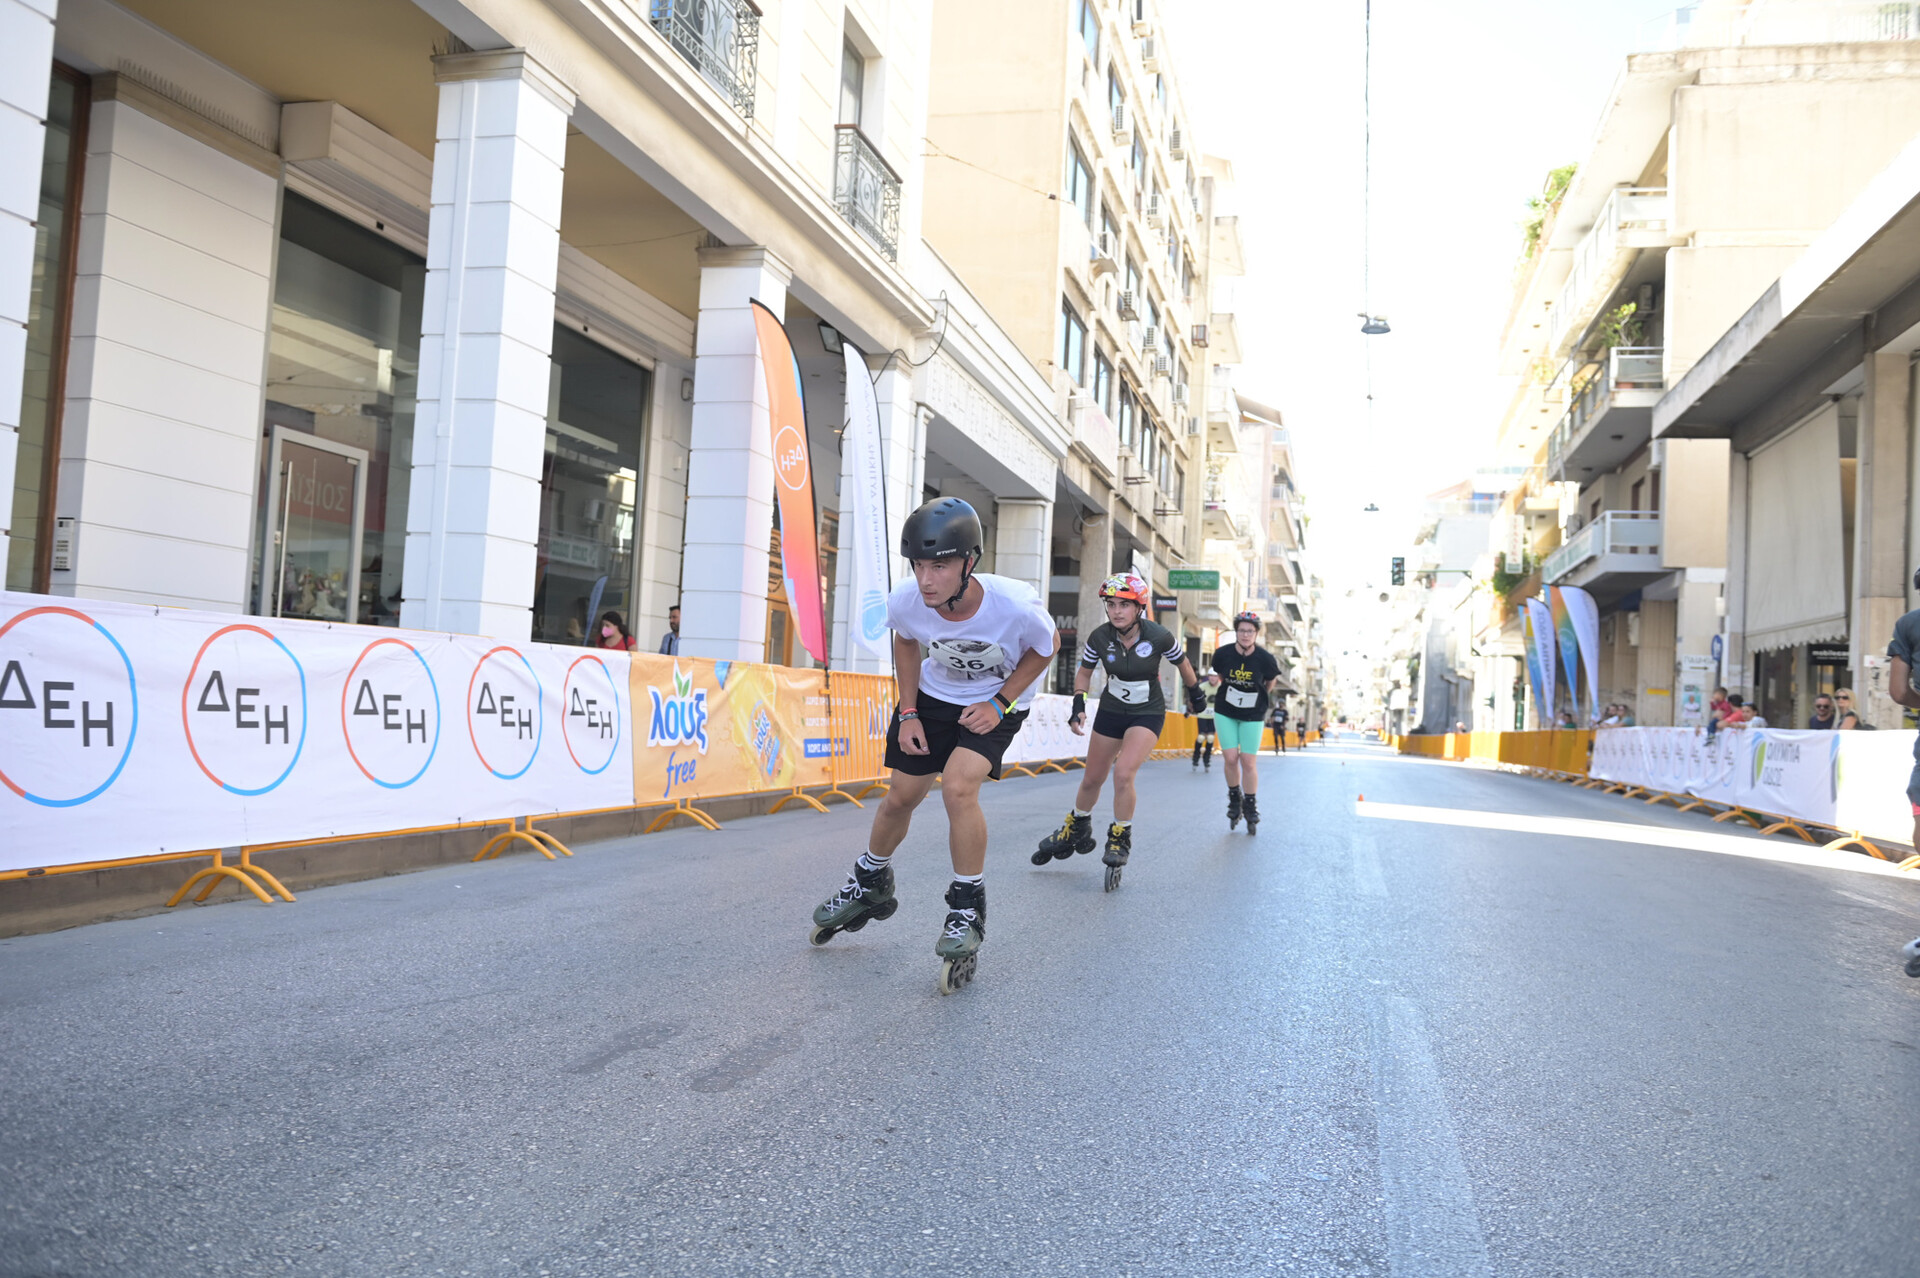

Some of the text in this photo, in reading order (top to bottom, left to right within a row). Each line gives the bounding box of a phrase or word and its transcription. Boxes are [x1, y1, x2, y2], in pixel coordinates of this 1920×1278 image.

[949, 656, 985, 670] 36
[1229, 669, 1253, 680] LOVE
[0, 661, 114, 747] ΔΕΗ
[197, 671, 289, 745] ΔΕΗ
[353, 680, 426, 744] ΔΕΗ
[476, 683, 533, 740] ΔΕΗ
[570, 688, 613, 739] ΔΕΗ
[1121, 688, 1131, 702] 2
[1238, 697, 1243, 706] 1
[664, 751, 697, 798] free
